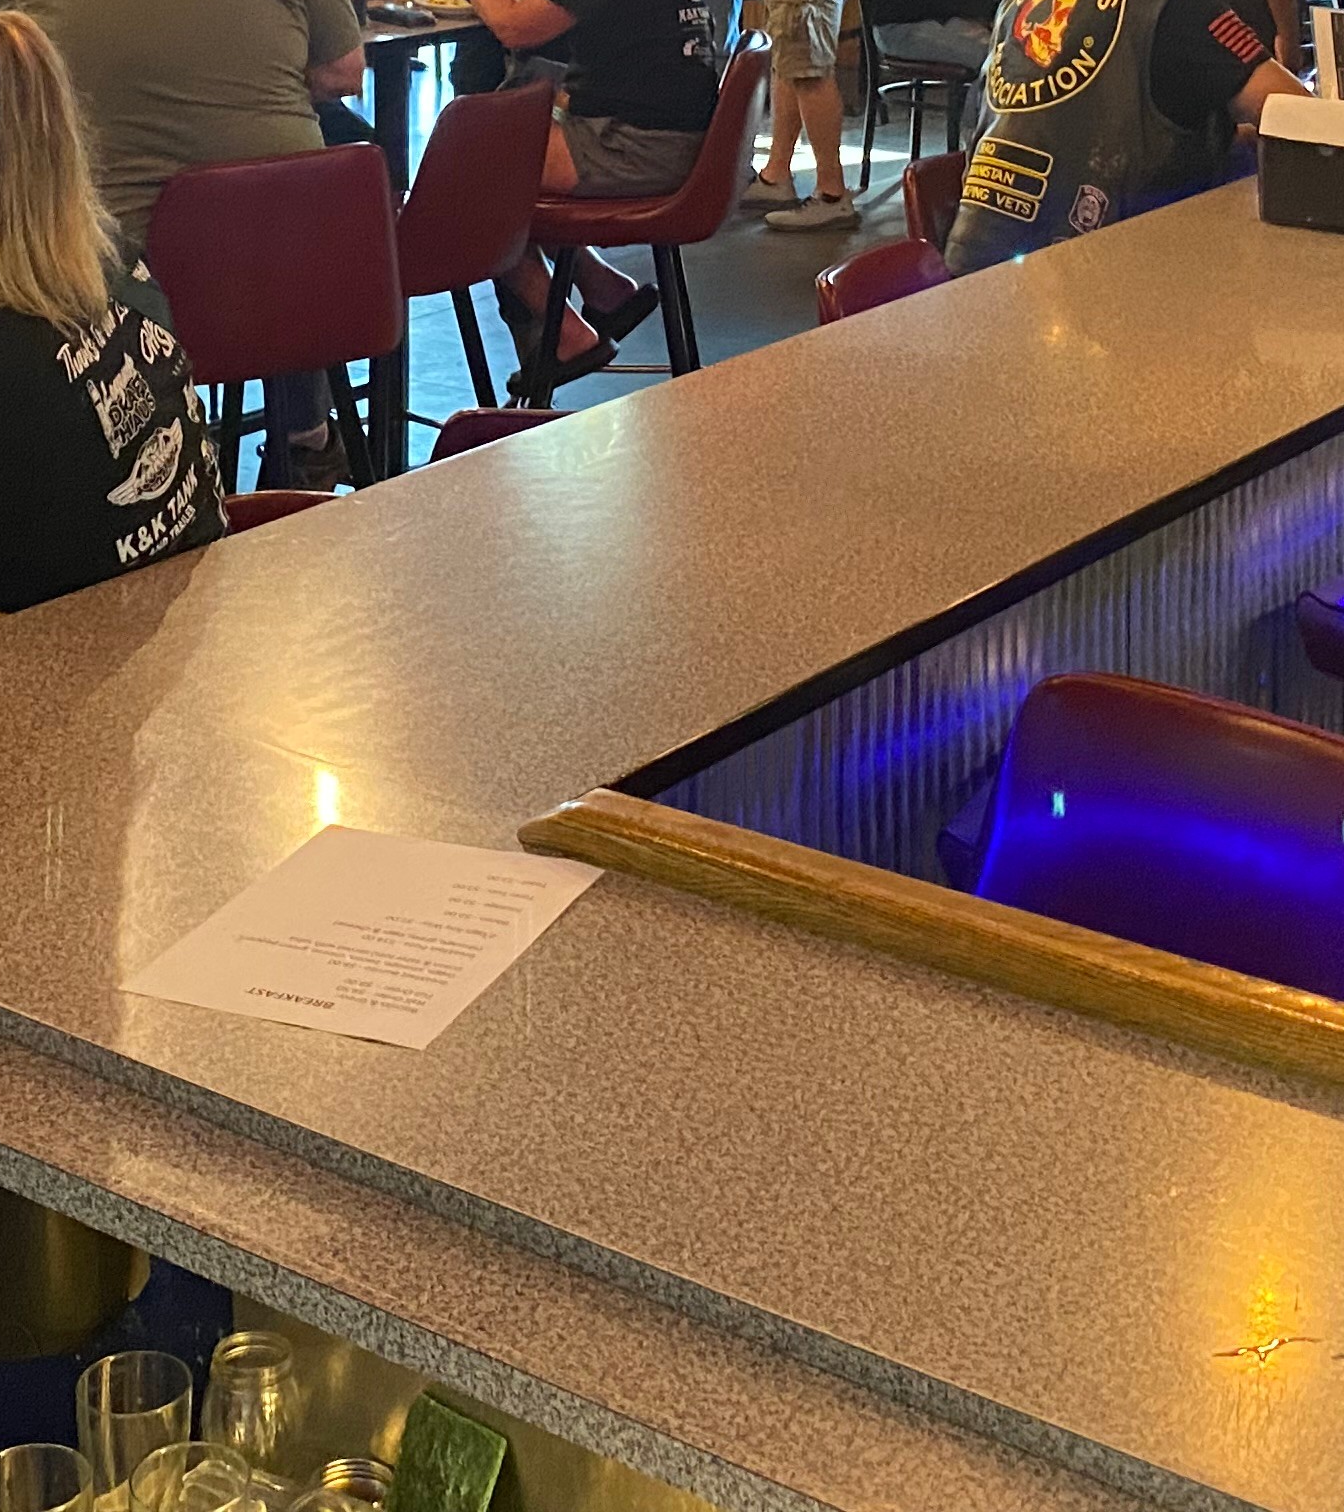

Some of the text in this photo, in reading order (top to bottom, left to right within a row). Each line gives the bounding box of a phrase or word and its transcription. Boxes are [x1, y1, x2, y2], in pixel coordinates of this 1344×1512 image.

[996, 191, 1032, 217] VETS
[114, 512, 167, 564] K&K
[244, 986, 336, 1009] BREAKFAST
